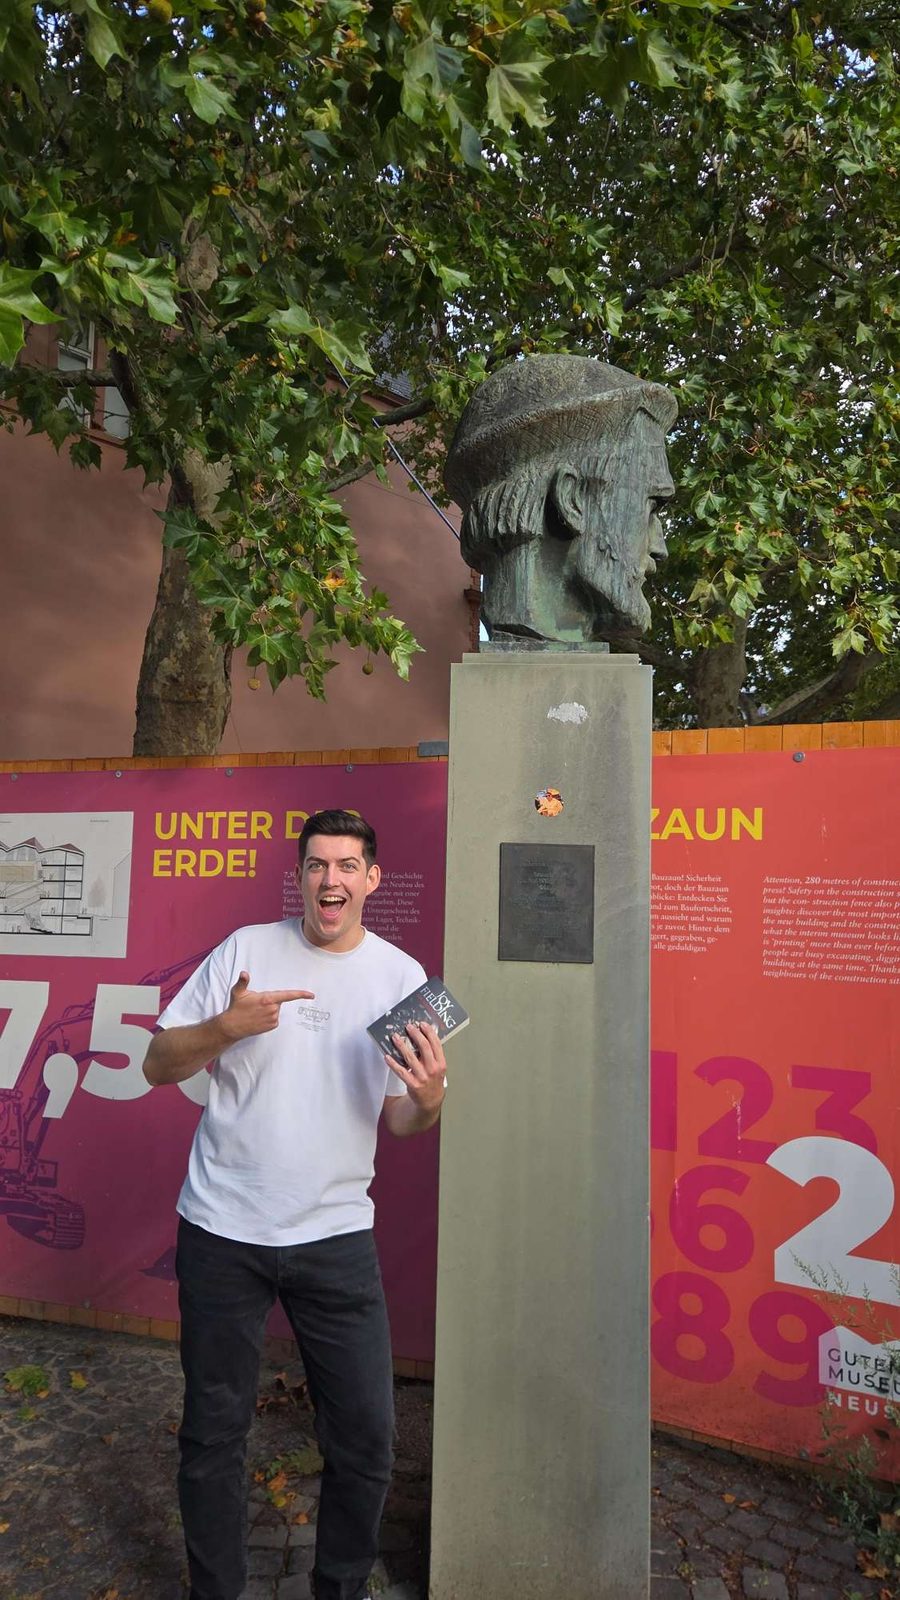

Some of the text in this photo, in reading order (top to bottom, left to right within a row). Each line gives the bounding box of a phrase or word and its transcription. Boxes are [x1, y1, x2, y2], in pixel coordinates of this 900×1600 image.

[155, 811, 273, 840] UNTER
[153, 849, 257, 878] ERDE!
[391, 872, 424, 880] Geschichte
[652, 873, 722, 882] Bauzaun! Sicherheit
[764, 876, 802, 884] Attention,
[852, 877, 861, 889] of
[763, 886, 786, 894] press!
[788, 887, 812, 896] Safety
[842, 889, 894, 897] construction
[678, 894, 715, 902] Entdecken
[716, 894, 728, 902] Sie
[812, 898, 849, 906] struction
[850, 899, 872, 908] fence
[680, 904, 732, 913] Baufortschritt,
[797, 908, 832, 916] discover
[763, 916, 776, 925] the
[796, 918, 829, 928] building
[849, 920, 862, 928] the
[670, 934, 706, 943] gegraben,
[763, 927, 782, 935] what
[785, 928, 796, 936] the
[799, 929, 828, 937] interim
[830, 931, 864, 939] museum
[868, 931, 890, 940] looks
[667, 942, 707, 952] geduldigen
[833, 941, 852, 949] than
[763, 948, 789, 957] people
[805, 950, 824, 959] busy
[826, 953, 874, 961] excavating,
[763, 958, 795, 968] building
[846, 963, 866, 972] time.
[763, 969, 807, 978] neighbours
[809, 972, 818, 981] of
[820, 972, 832, 980] the
[835, 974, 887, 984] construction
[436, 991, 454, 1008] JOY
[420, 986, 456, 1029] FIELDING
